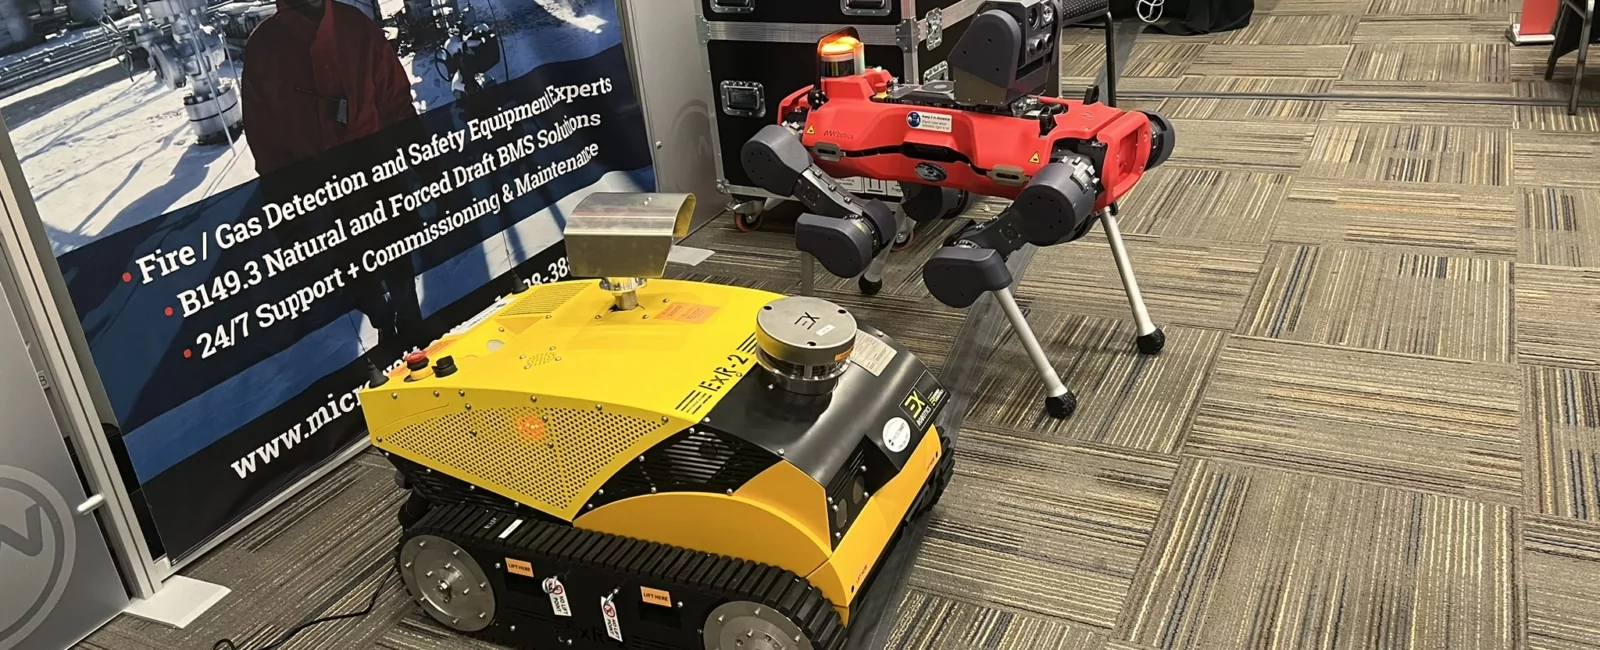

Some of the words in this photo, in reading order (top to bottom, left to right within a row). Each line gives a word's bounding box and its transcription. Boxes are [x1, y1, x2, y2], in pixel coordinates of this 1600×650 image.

[135, 246, 197, 285] Fire
[202, 232, 208, 261] /
[215, 217, 263, 249] Gas
[262, 172, 369, 230] Detection
[372, 148, 410, 184] and
[409, 129, 467, 167] Safety
[546, 77, 613, 106] Experts
[177, 261, 263, 318] B149.3
[262, 218, 347, 278] Natural
[350, 200, 388, 237] and
[389, 171, 453, 218] Forced
[452, 152, 497, 189] Draft
[497, 135, 536, 168] BMS
[537, 113, 601, 149] Solutions
[196, 312, 250, 359] 24/7
[255, 267, 345, 328] Support
[348, 263, 360, 279] +
[363, 194, 501, 273] Commissioning
[502, 184, 515, 204] &
[514, 143, 600, 198] Maintenance
[698, 354, 749, 392] ExR-2
[904, 390, 926, 419] EX
[508, 563, 518, 571] LIFT
[655, 594, 669, 602] HERE
